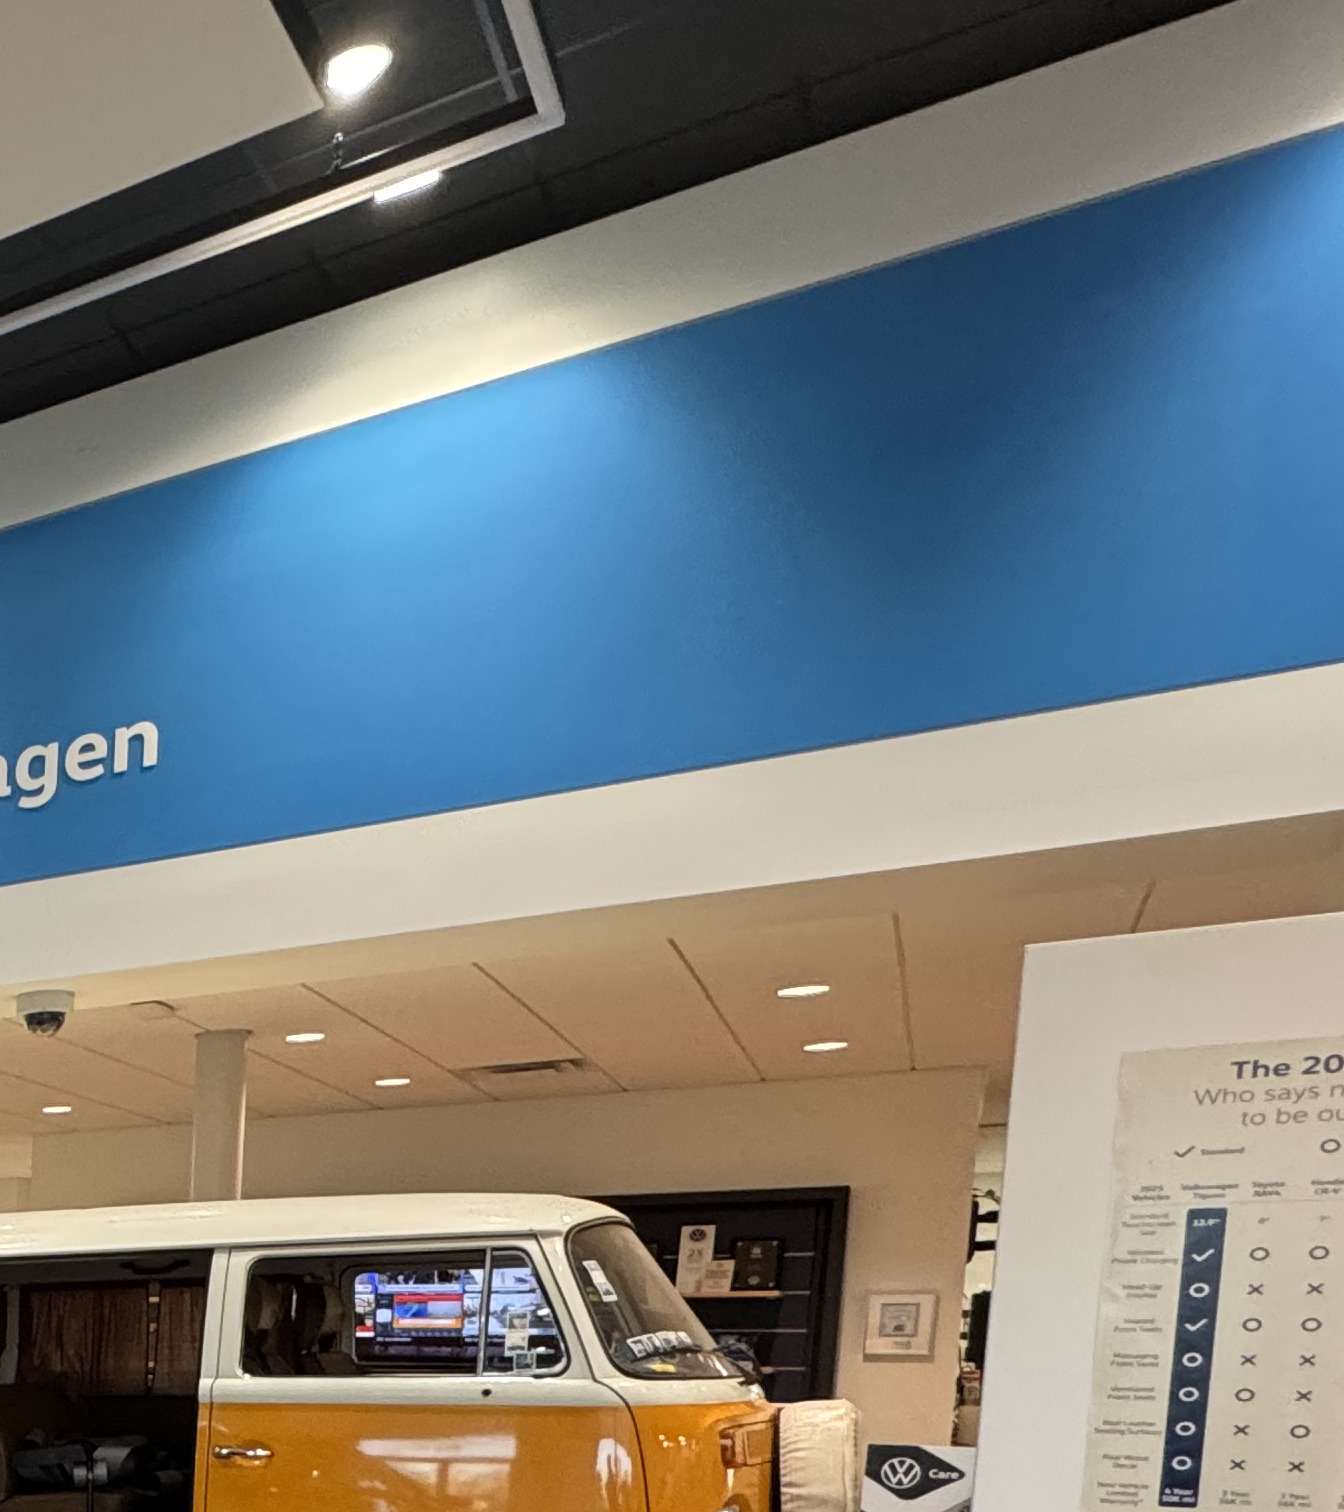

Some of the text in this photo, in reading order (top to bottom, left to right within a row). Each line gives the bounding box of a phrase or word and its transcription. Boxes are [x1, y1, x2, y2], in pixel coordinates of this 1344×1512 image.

[1230, 1055, 1344, 1079] The 20
[1194, 1087, 1255, 1105] Who
[1264, 1084, 1321, 1104] says
[1241, 1111, 1266, 1126] to
[1275, 1108, 1309, 1124] be
[928, 1469, 960, 1480] Care
